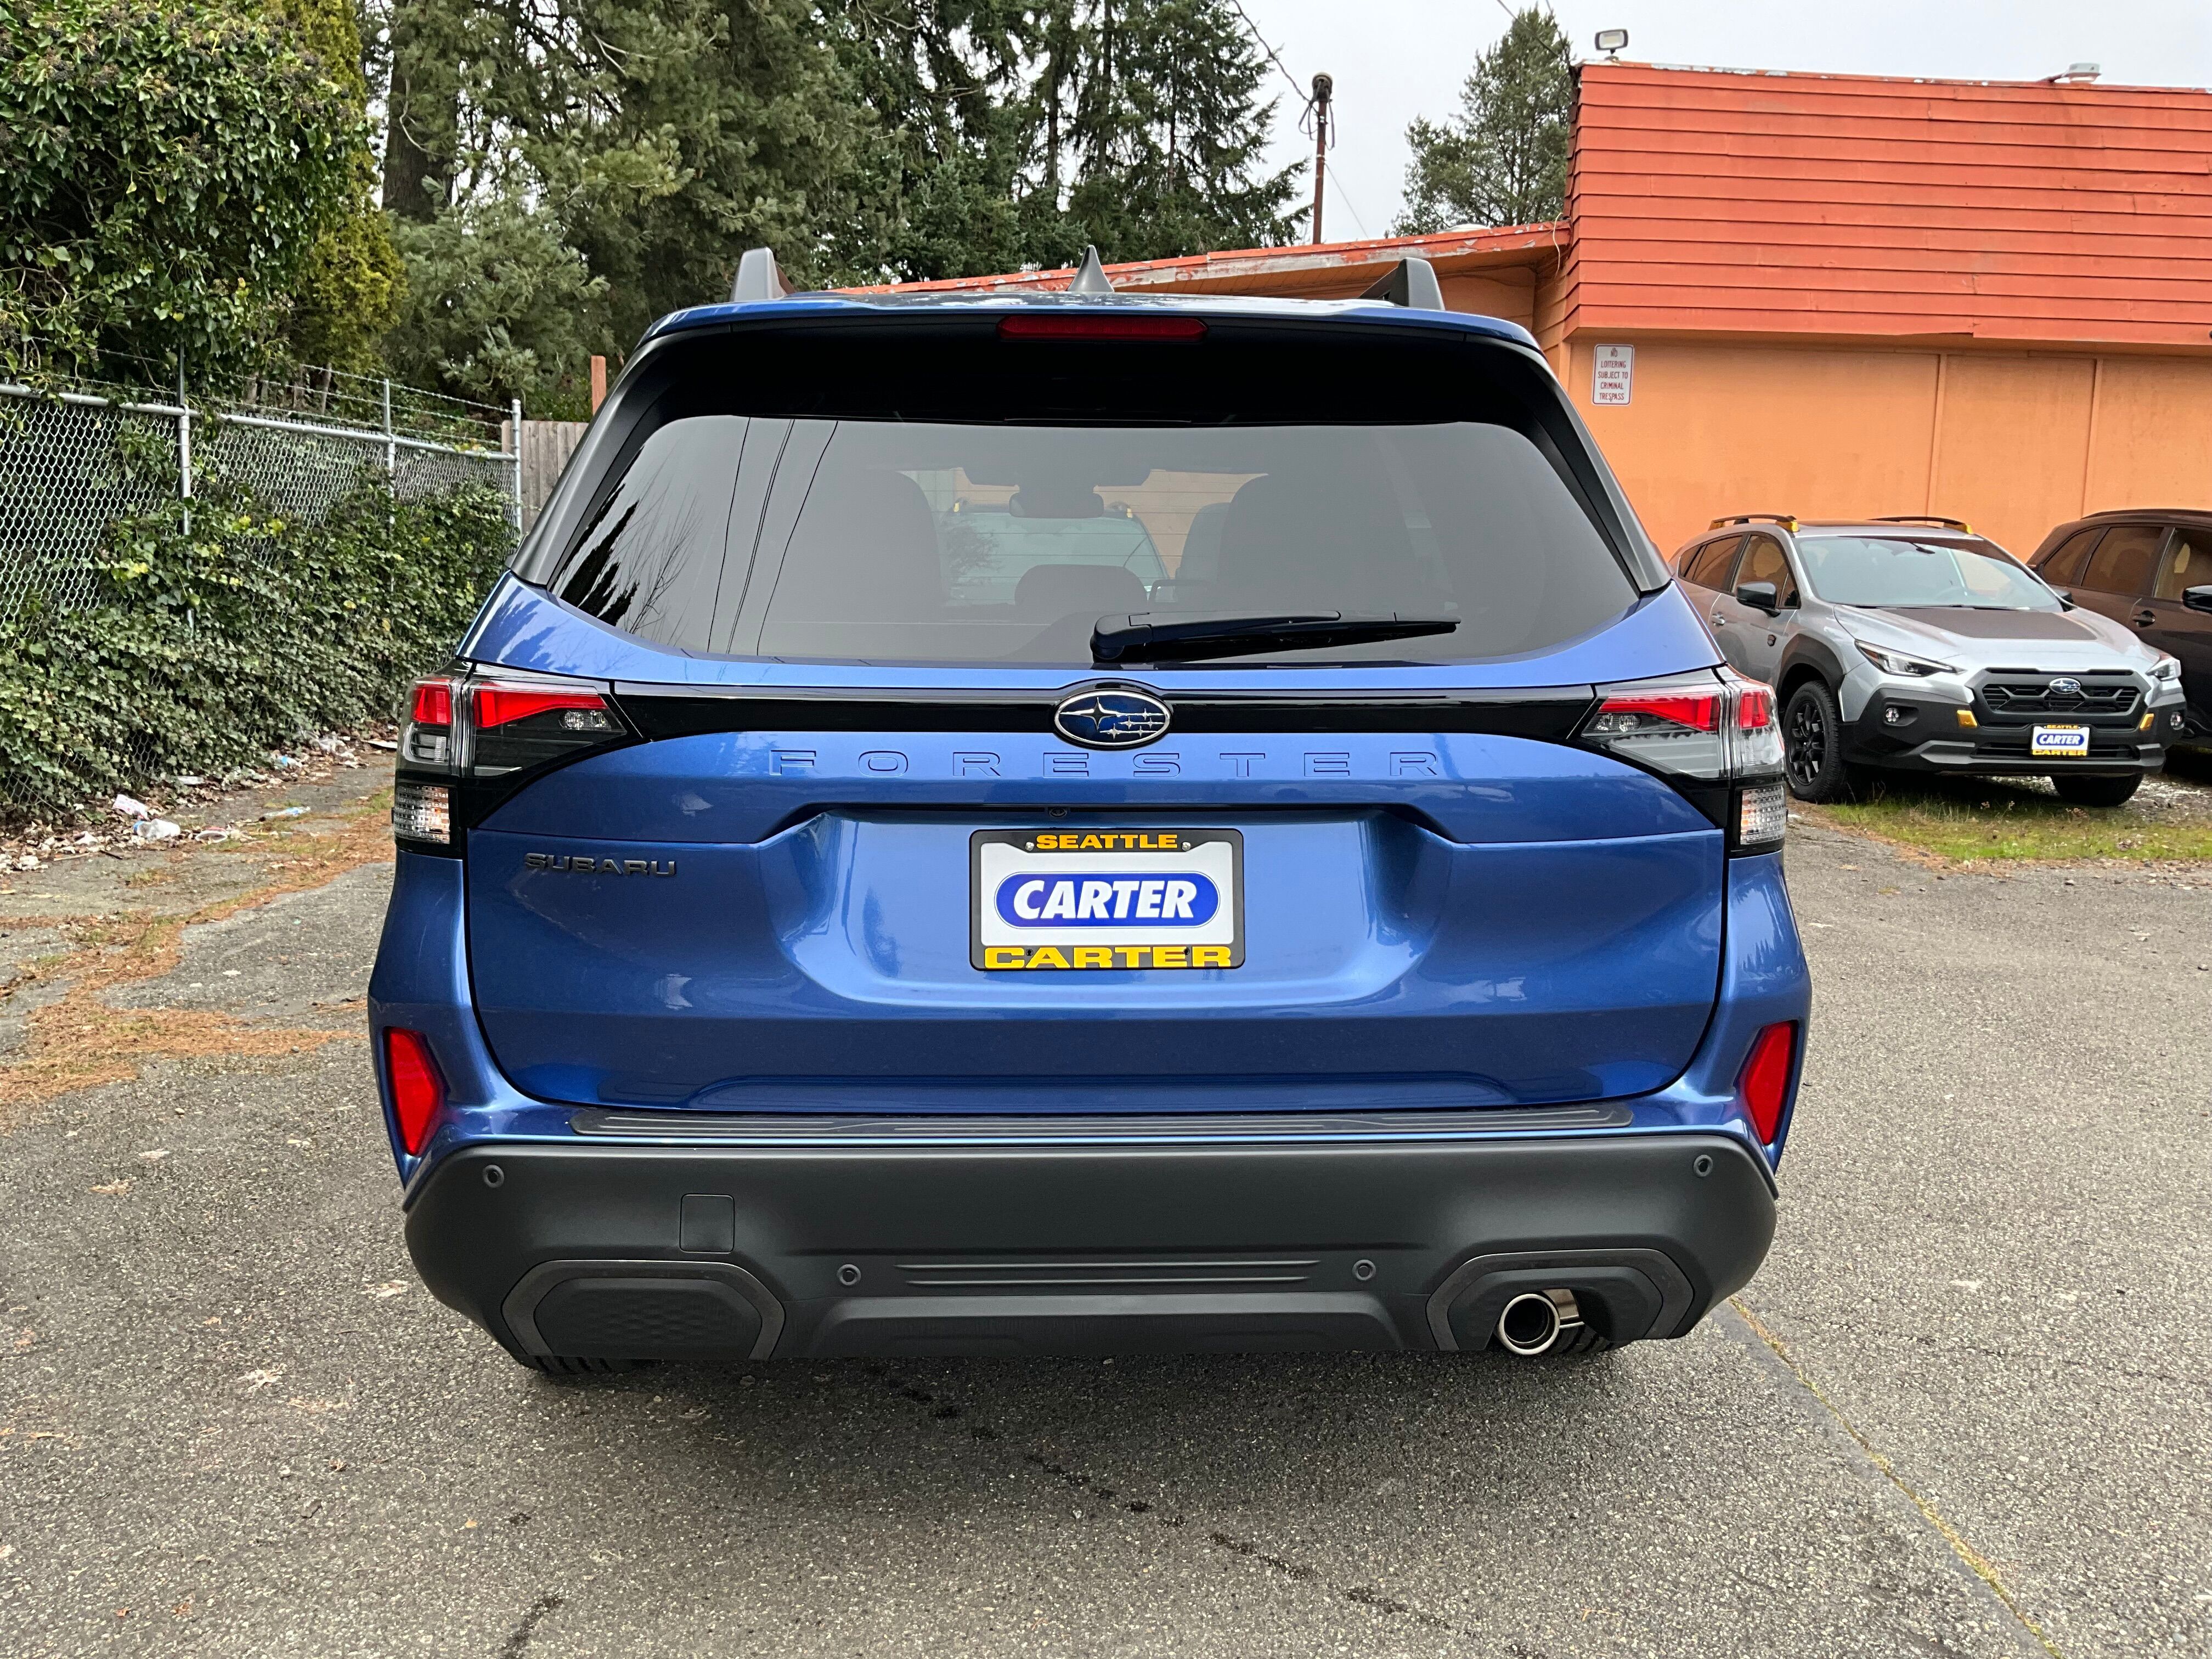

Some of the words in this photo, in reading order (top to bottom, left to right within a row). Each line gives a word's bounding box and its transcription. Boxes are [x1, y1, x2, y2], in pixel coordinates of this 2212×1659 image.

[1599, 392, 1624, 400] TRESPASS
[2039, 735, 2080, 744] CARTER
[769, 749, 1438, 778] FORESTER
[1036, 834, 1178, 850] SEATTLE
[524, 853, 677, 876] SUBARU
[1013, 879, 1197, 919] CARTER
[984, 946, 1231, 969] CARTER
